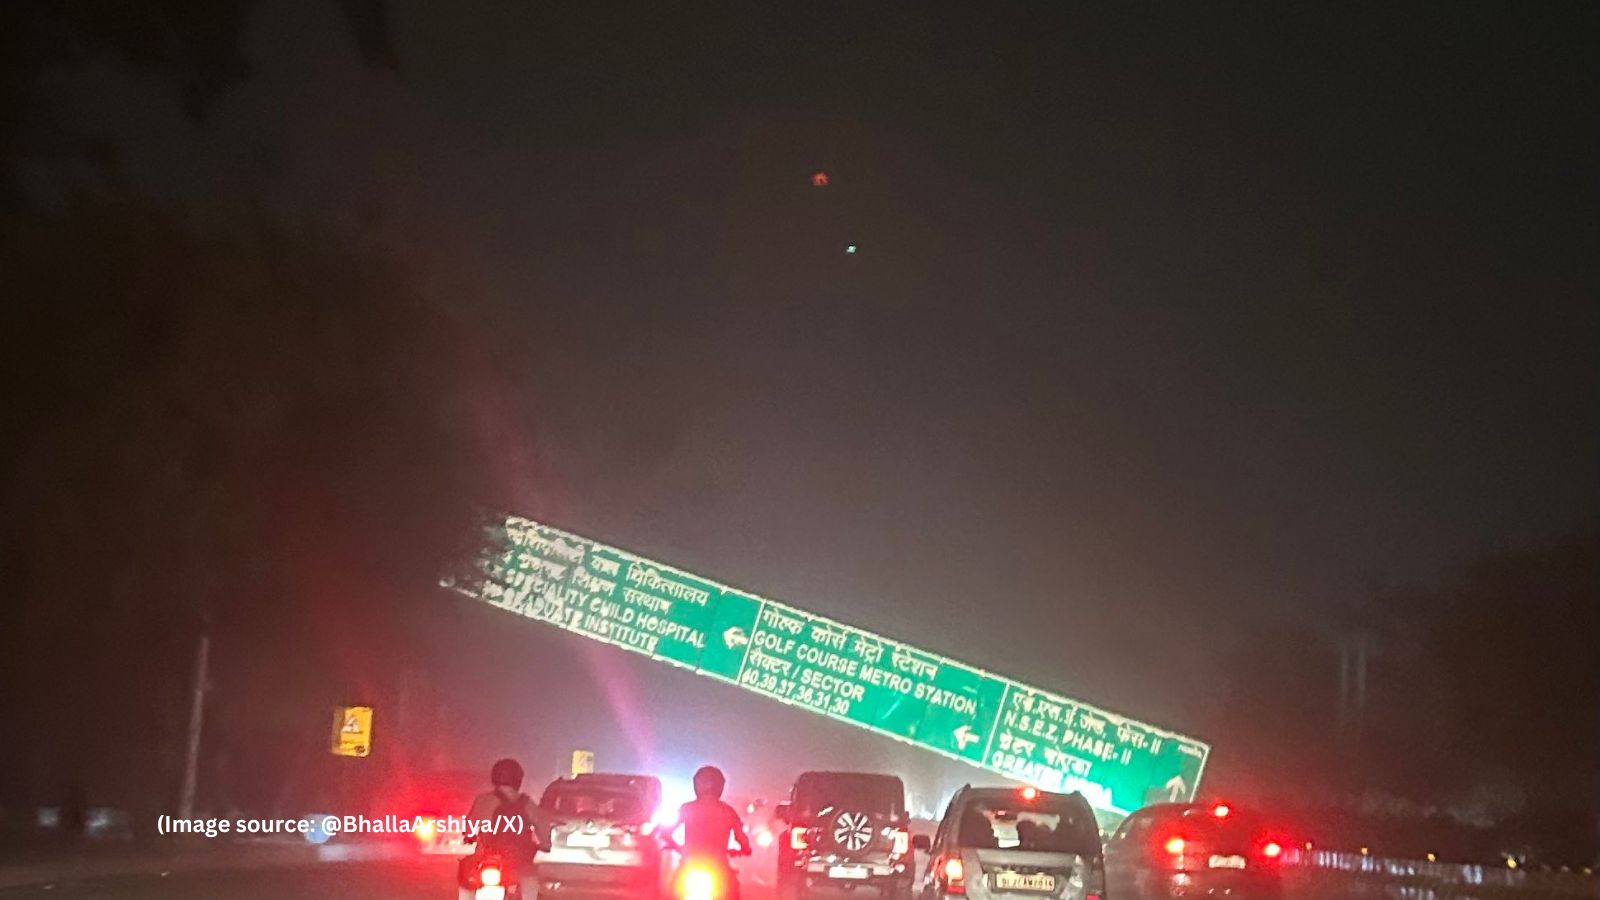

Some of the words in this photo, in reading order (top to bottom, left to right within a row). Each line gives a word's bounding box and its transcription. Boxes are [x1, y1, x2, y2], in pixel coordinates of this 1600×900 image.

[590, 597, 635, 624] CHILD
[635, 612, 706, 649] HOSPITAL
[811, 624, 848, 651] कोर्स
[753, 630, 796, 655] GOLF
[796, 643, 859, 677] COURSE
[859, 664, 914, 695] METRO
[800, 667, 866, 703] SECTOR
